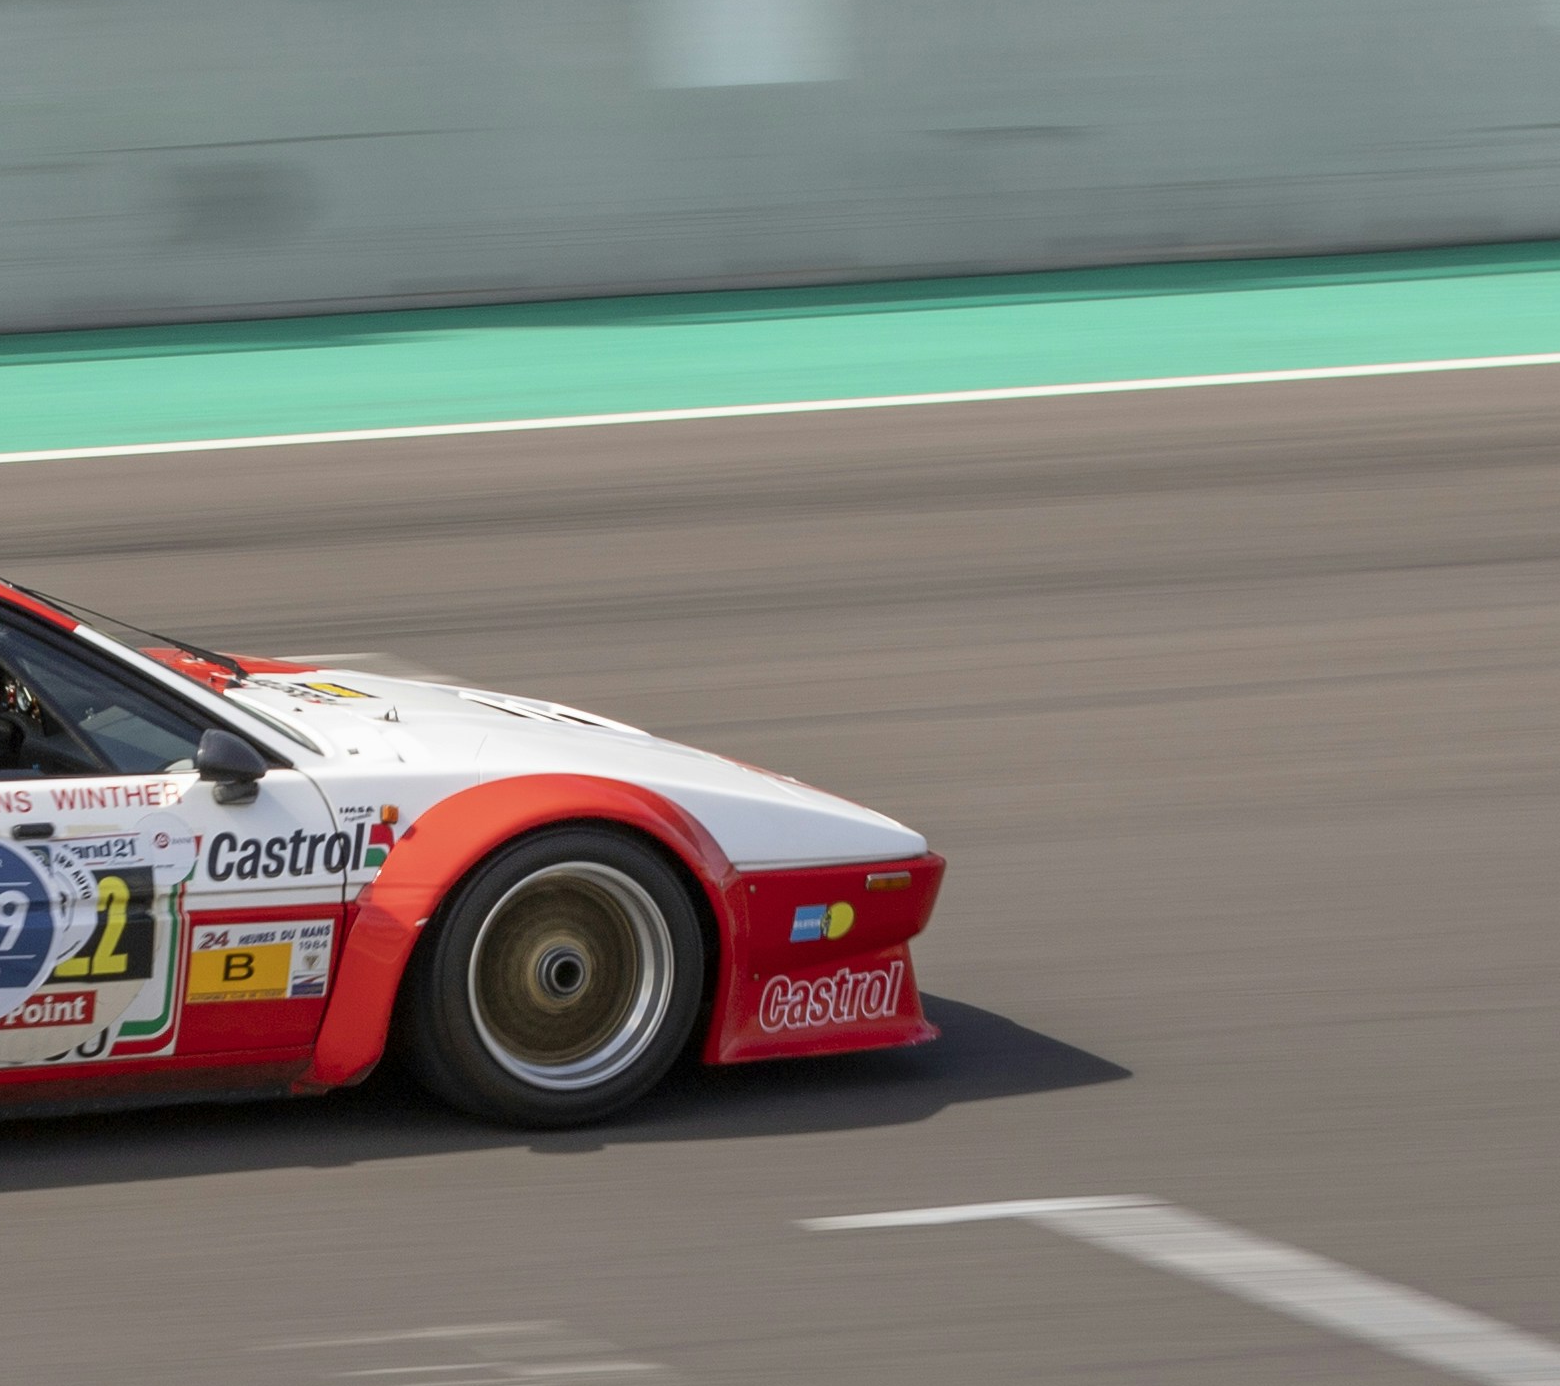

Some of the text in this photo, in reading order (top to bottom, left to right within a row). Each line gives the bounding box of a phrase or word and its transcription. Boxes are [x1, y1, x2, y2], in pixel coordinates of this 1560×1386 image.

[50, 781, 183, 811] WINTHER
[208, 822, 366, 882] Castrol
[198, 929, 230, 950] 24
[280, 929, 296, 941] DU
[300, 924, 331, 938] MANS
[222, 952, 256, 983] B
[758, 960, 905, 1034] Castrol
